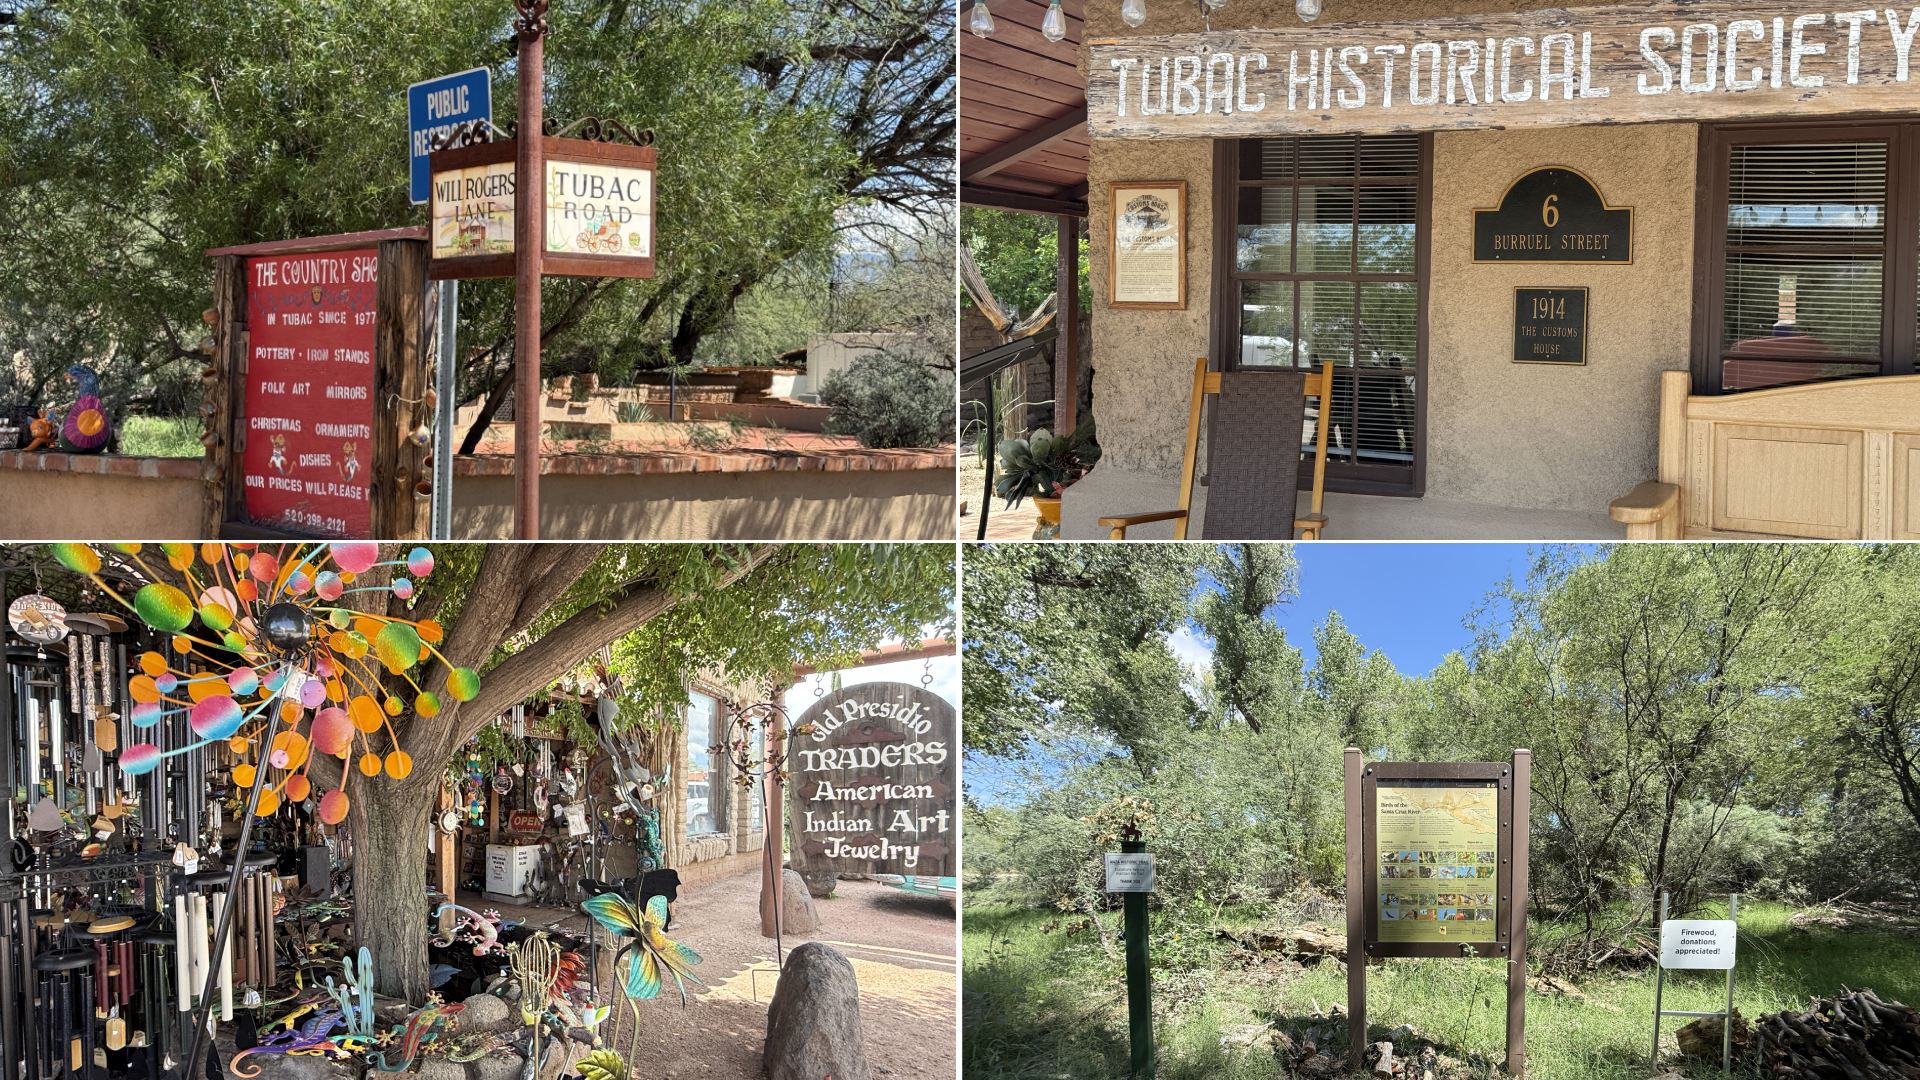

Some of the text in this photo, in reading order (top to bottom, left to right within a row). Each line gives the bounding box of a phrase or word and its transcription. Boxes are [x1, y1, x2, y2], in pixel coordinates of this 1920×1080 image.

[1111, 7, 1920, 117] TUBAC HISTORICAL SOCIETY
[427, 84, 470, 121] PUBLIC
[434, 172, 516, 203] WILL ROGERS
[555, 171, 642, 202] TUBAC
[455, 201, 496, 223] LANE
[564, 201, 633, 224] ROAD
[1542, 194, 1560, 228] 6
[1494, 234, 1610, 250] BURRUEL STREET
[256, 256, 378, 287] THE COUNTRY SHO
[267, 311, 377, 326] IN TUBAC SINCE 1977
[1532, 297, 1565, 320] 1914
[1521, 326, 1578, 337] THE CUSTOMS
[255, 347, 370, 364] POTTERY IRON STANDS
[1533, 343, 1560, 355] HOUSE
[261, 381, 285, 394] FOLK
[292, 382, 311, 395] ART
[251, 417, 370, 439] CHRISTMAS ORNAMENTS
[300, 453, 332, 467] DISHES
[245, 474, 265, 488] OUR
[269, 477, 302, 491] PRICES
[305, 483, 327, 496] WILL
[328, 483, 362, 500] PLEASE
[836, 695, 932, 735] Presidio
[799, 741, 948, 772] TRADERS
[810, 776, 934, 801] American
[514, 816, 541, 827] OPEN
[803, 809, 950, 833] Indian Art
[823, 836, 921, 868] Jewelry
[1681, 929, 1717, 937] Firewood,
